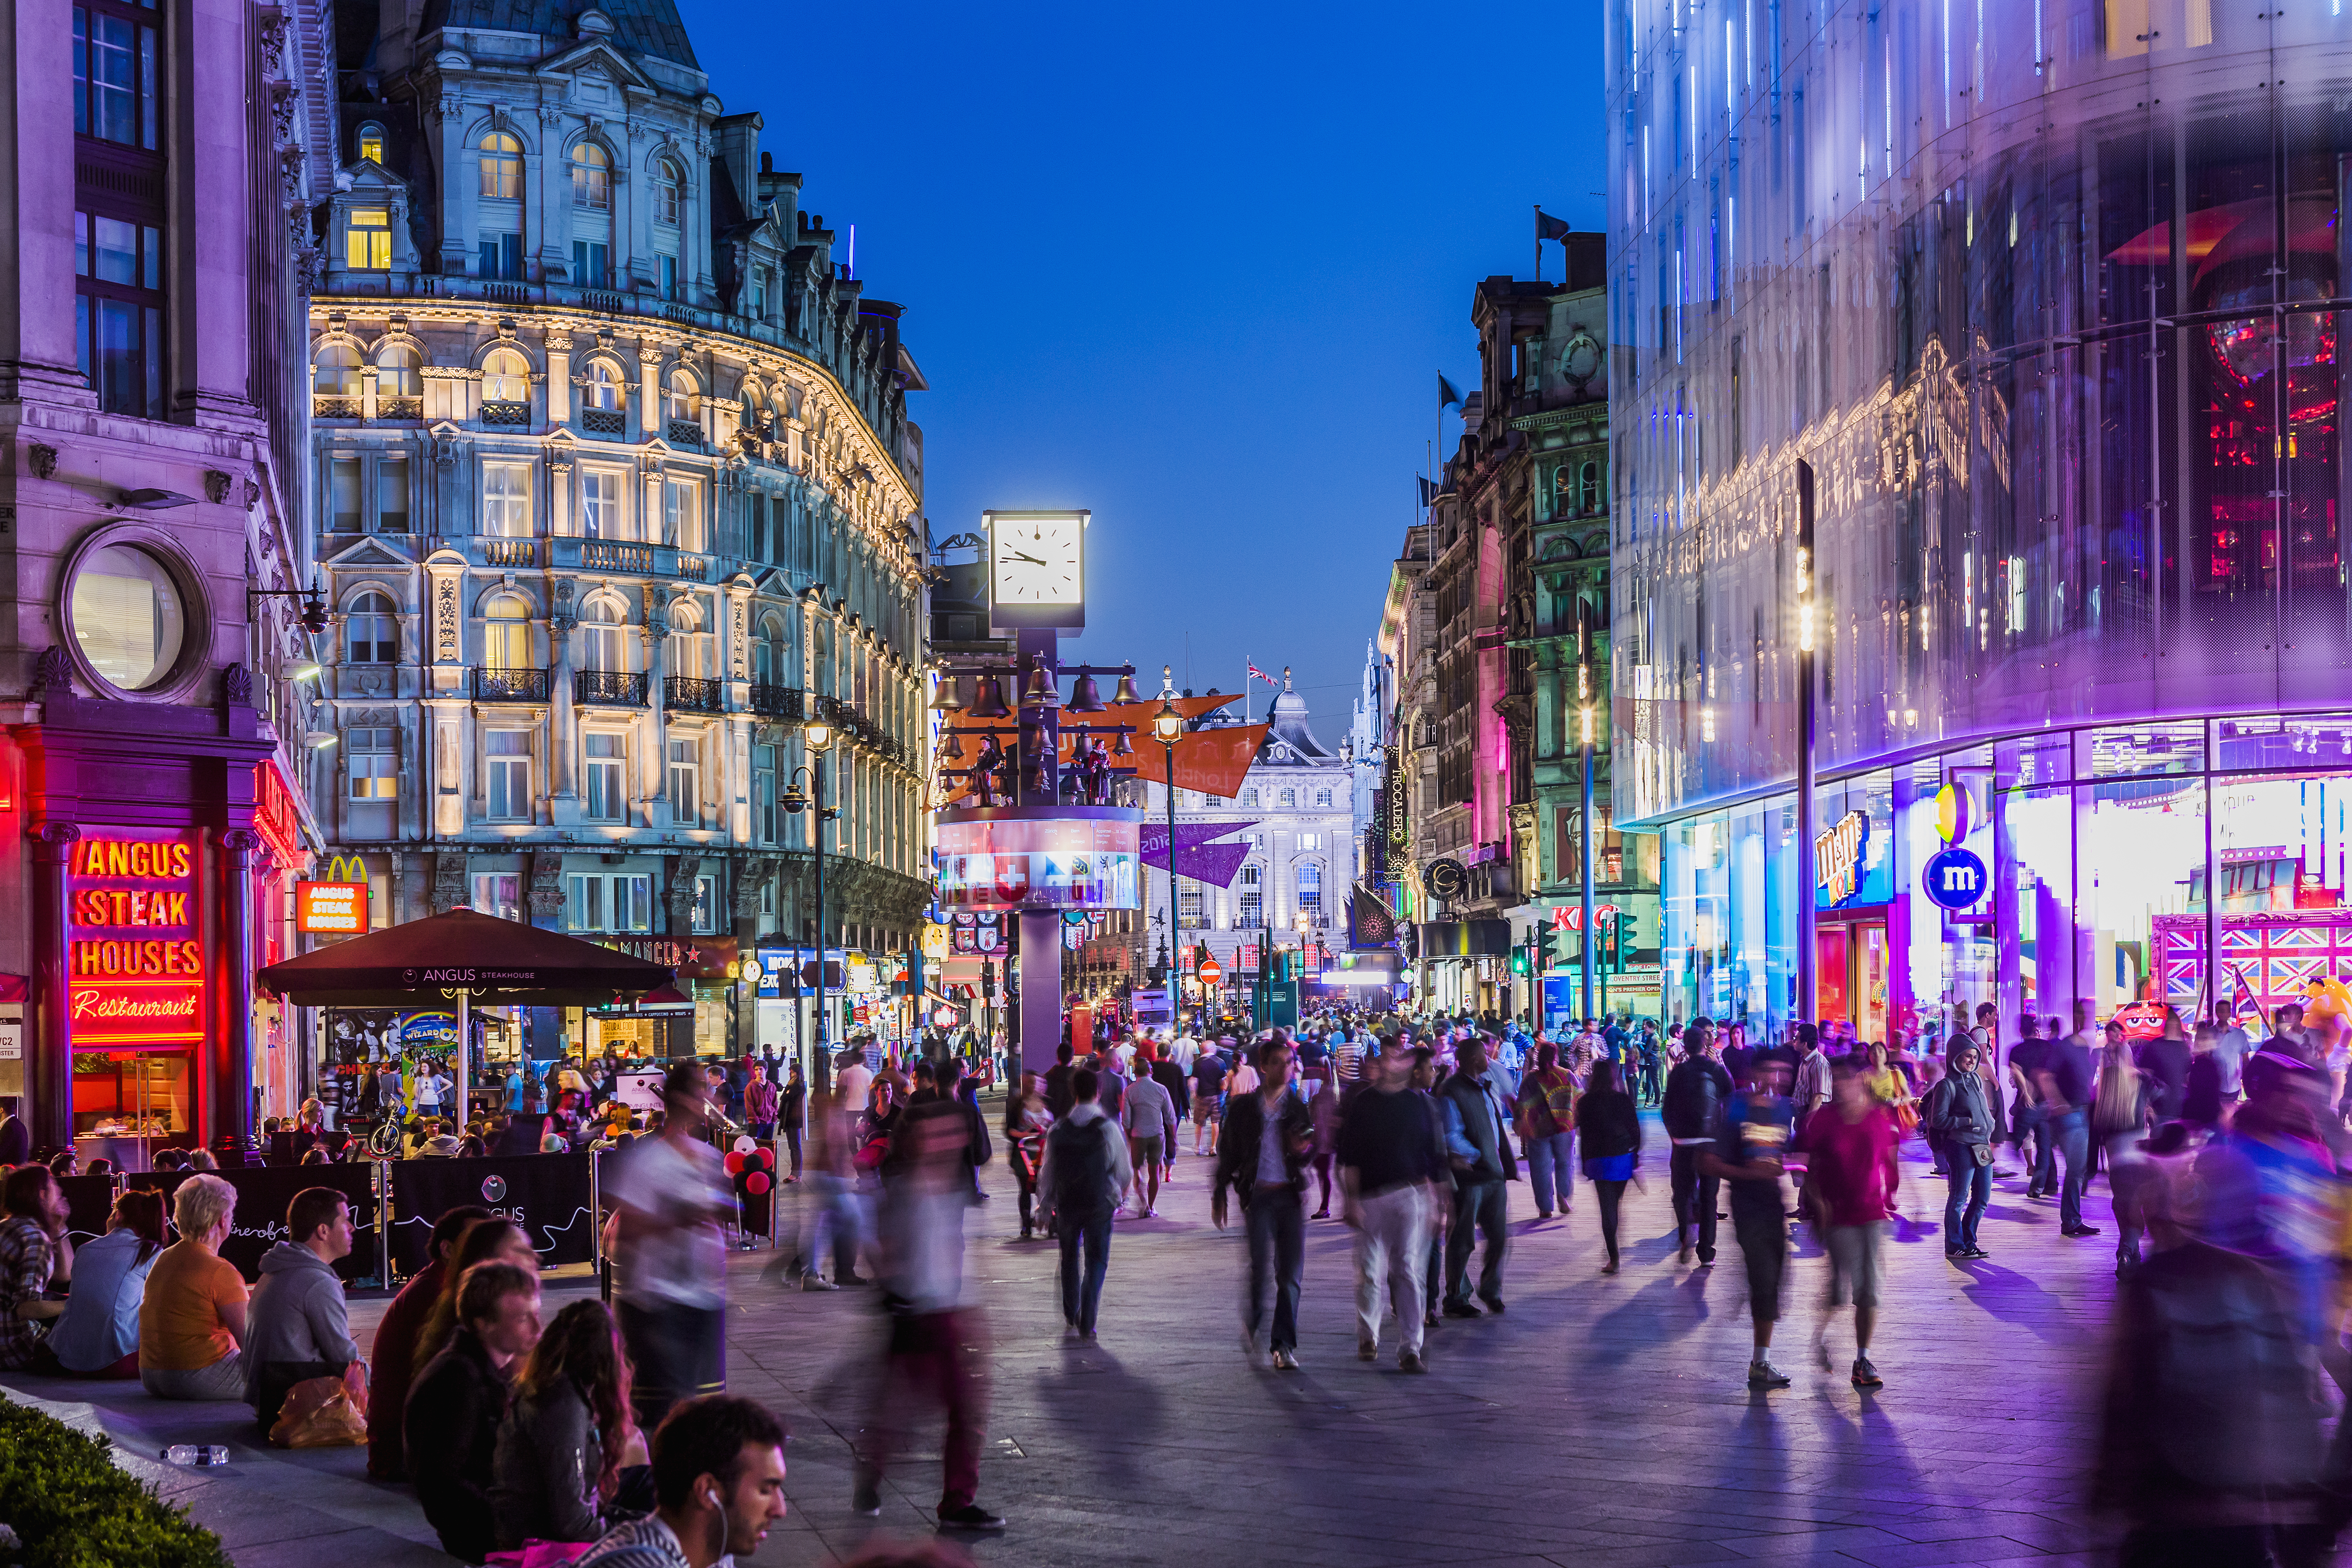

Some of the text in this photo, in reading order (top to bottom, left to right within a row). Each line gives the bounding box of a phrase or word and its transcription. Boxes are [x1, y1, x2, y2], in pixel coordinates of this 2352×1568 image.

[1393, 767, 1403, 840] TROCADERO
[85, 841, 191, 878] ANGUS
[1425, 859, 1466, 877] GROSVENOR
[1943, 867, 1975, 890] m
[310, 887, 354, 899] ANGUS
[1429, 890, 1462, 901] CASINOS
[88, 890, 189, 926] STEAK
[312, 902, 352, 914] STEAK
[307, 916, 357, 928] HOUSES
[79, 941, 201, 975] HOUSES
[423, 969, 475, 981] ANGUS
[75, 990, 196, 1019] Restaurant
[603, 1022, 634, 1031] NATURAL FOOD
[0, 1037, 13, 1045] C2
[405, 1029, 439, 1040] WIZARD
[488, 1207, 524, 1222] GUS
